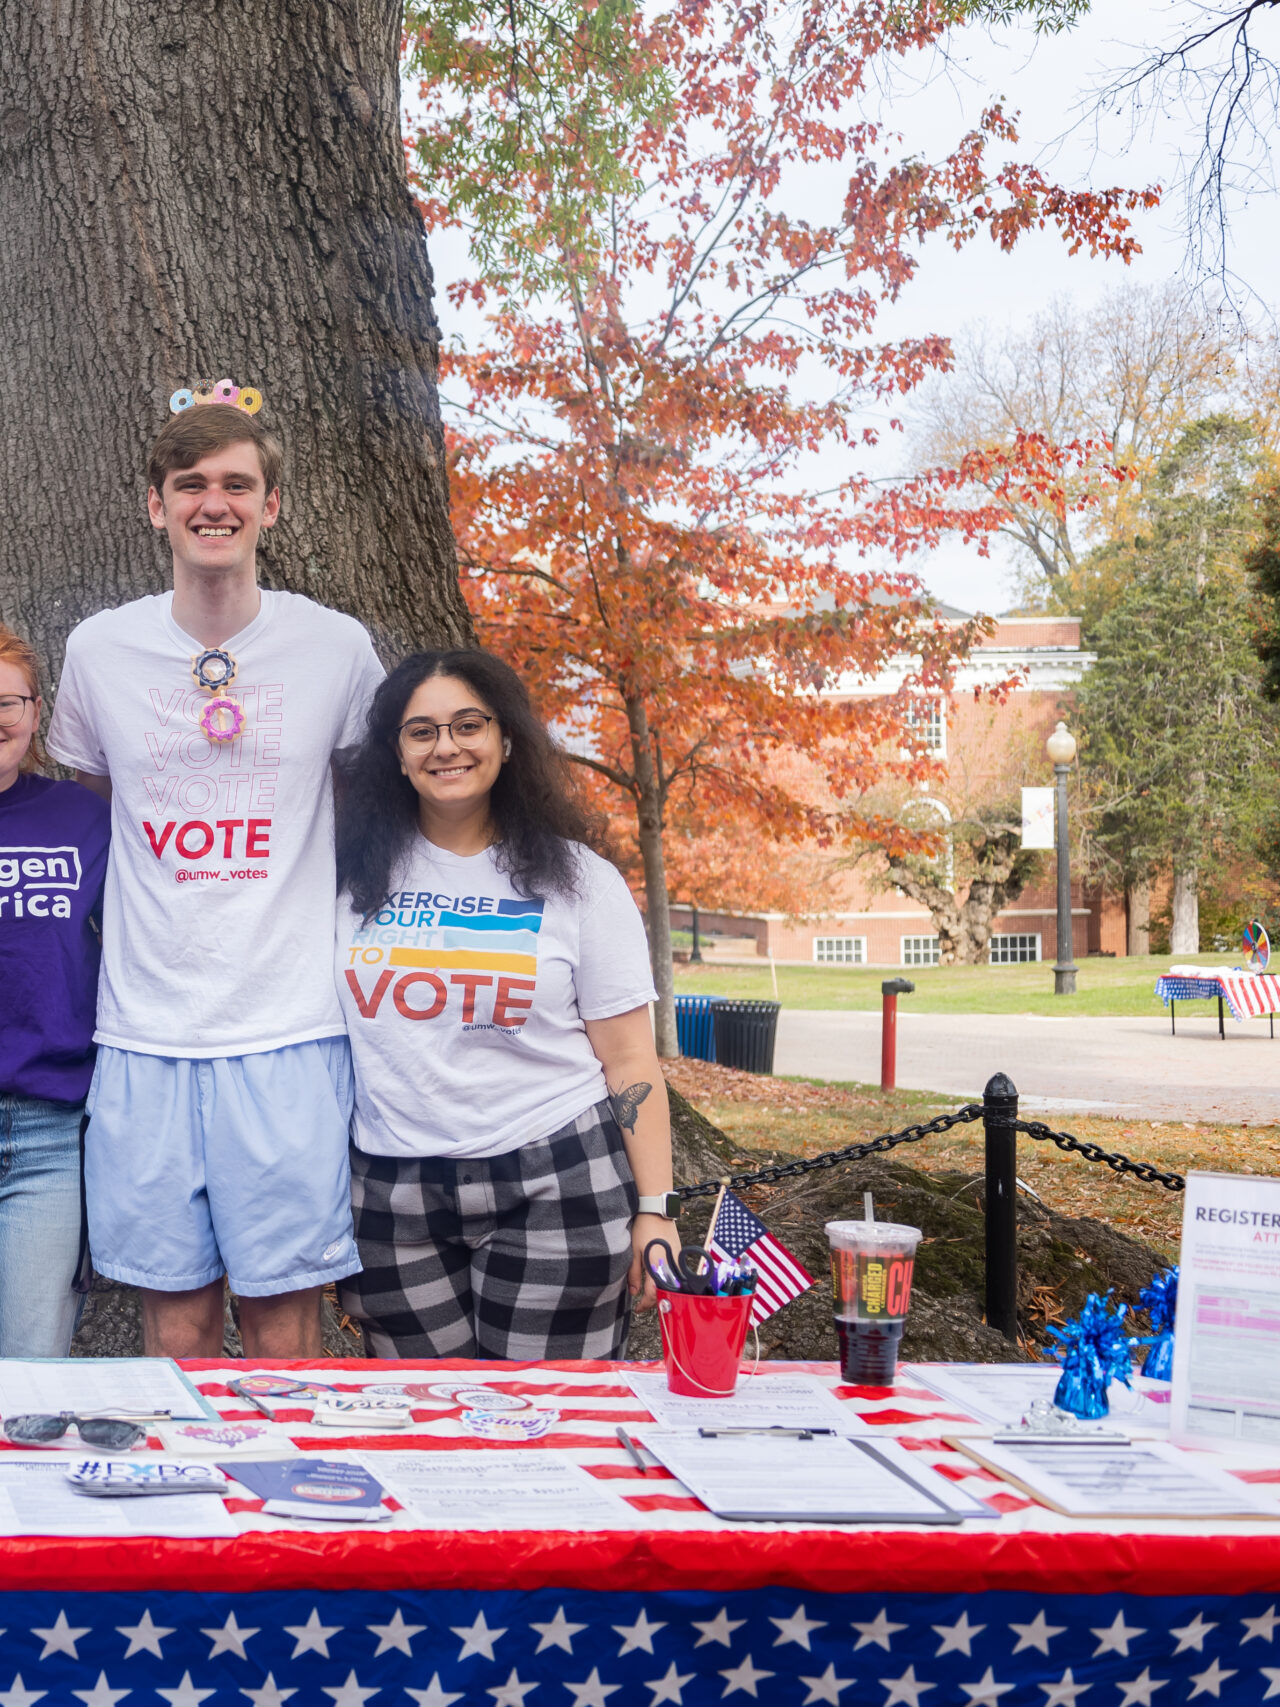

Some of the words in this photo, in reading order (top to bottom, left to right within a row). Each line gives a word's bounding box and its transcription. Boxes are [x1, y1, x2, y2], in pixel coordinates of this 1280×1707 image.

[144, 727, 282, 771] VOTE
[142, 772, 279, 816] VOTE
[142, 818, 272, 860] VOTE
[174, 867, 269, 884] @umw_votes
[383, 891, 495, 914] XERCISE
[347, 946, 385, 965] TO
[350, 928, 438, 948] RIGHT
[344, 968, 537, 1028] VOTE
[866, 1263, 883, 1313] CHARGED
